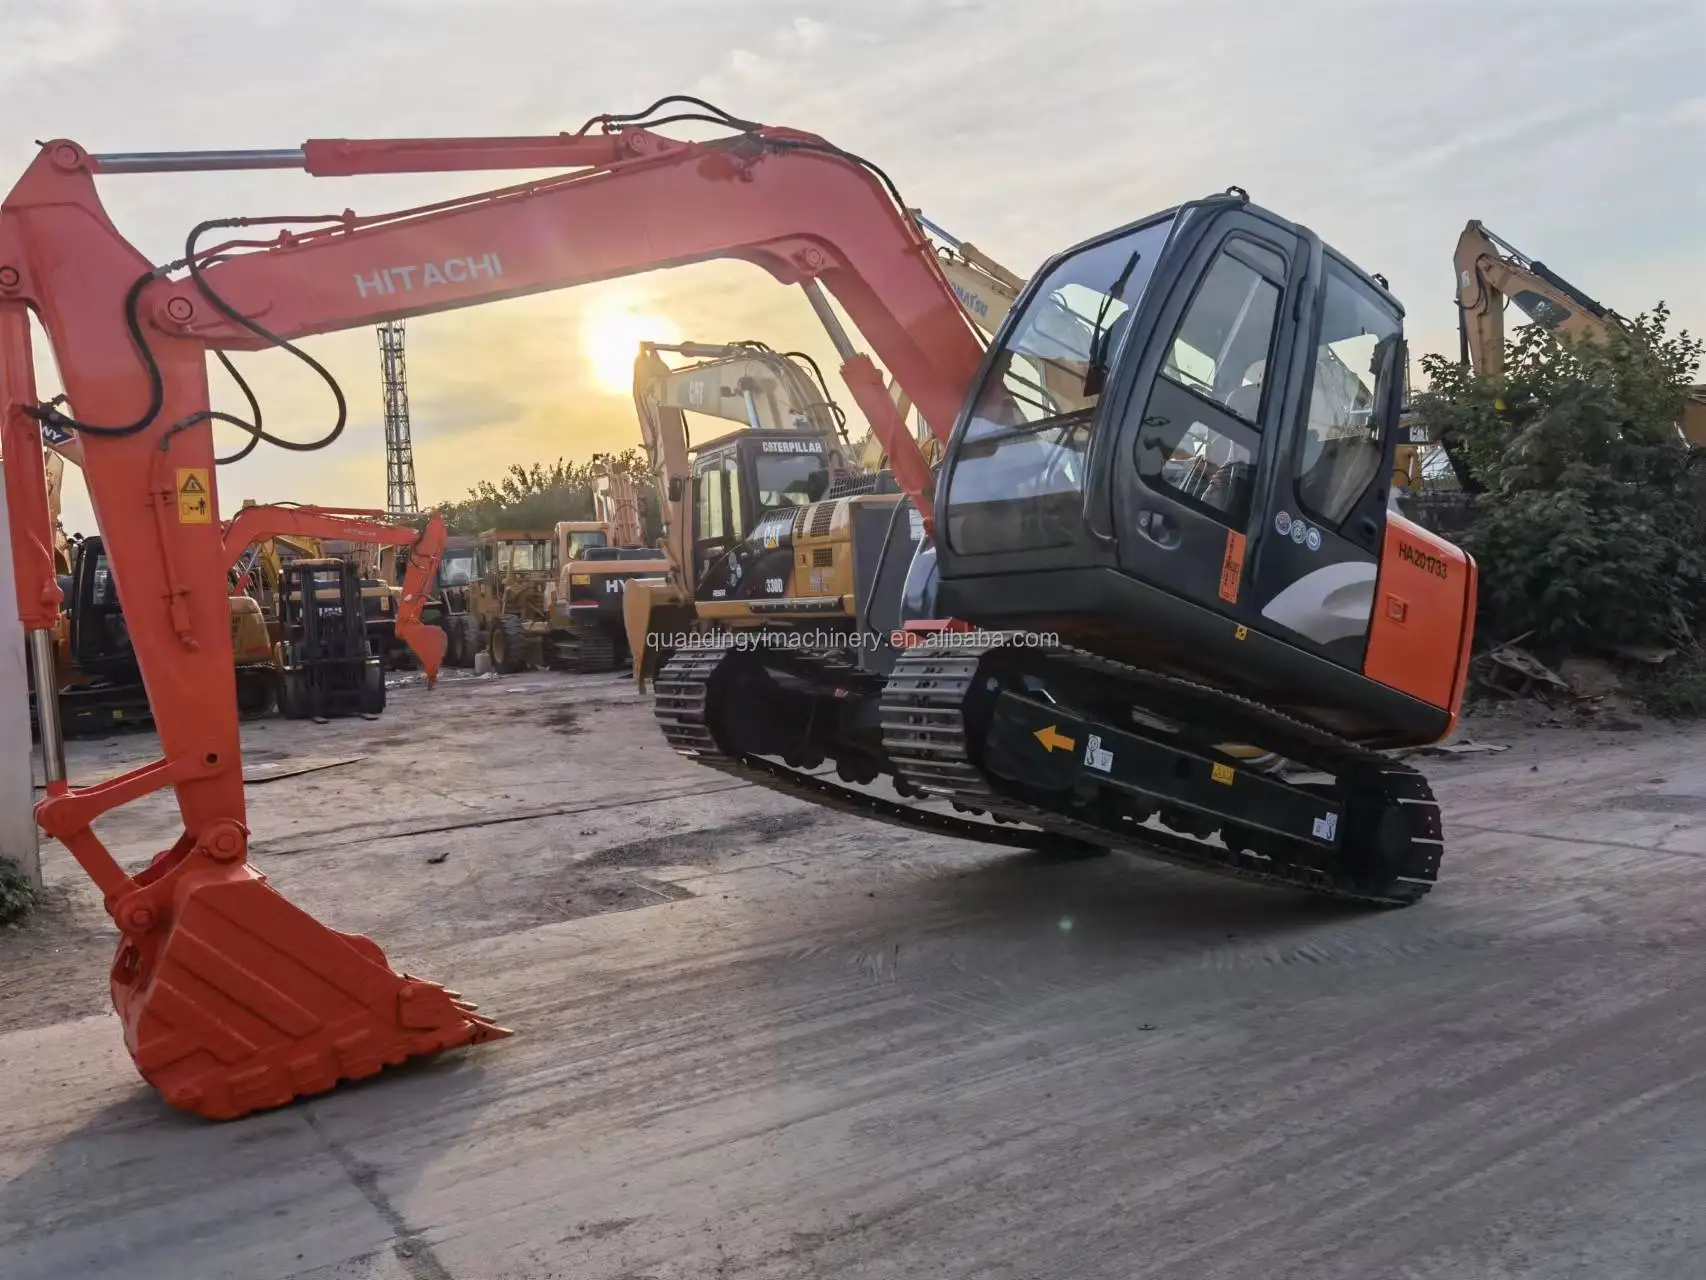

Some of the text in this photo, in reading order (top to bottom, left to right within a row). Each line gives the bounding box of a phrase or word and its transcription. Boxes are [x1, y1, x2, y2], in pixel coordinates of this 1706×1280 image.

[353, 252, 503, 298] HITACHI
[762, 441, 822, 453] CATERPILLAR
[1398, 541, 1448, 580] HA201733
[766, 578, 783, 593] 330D
